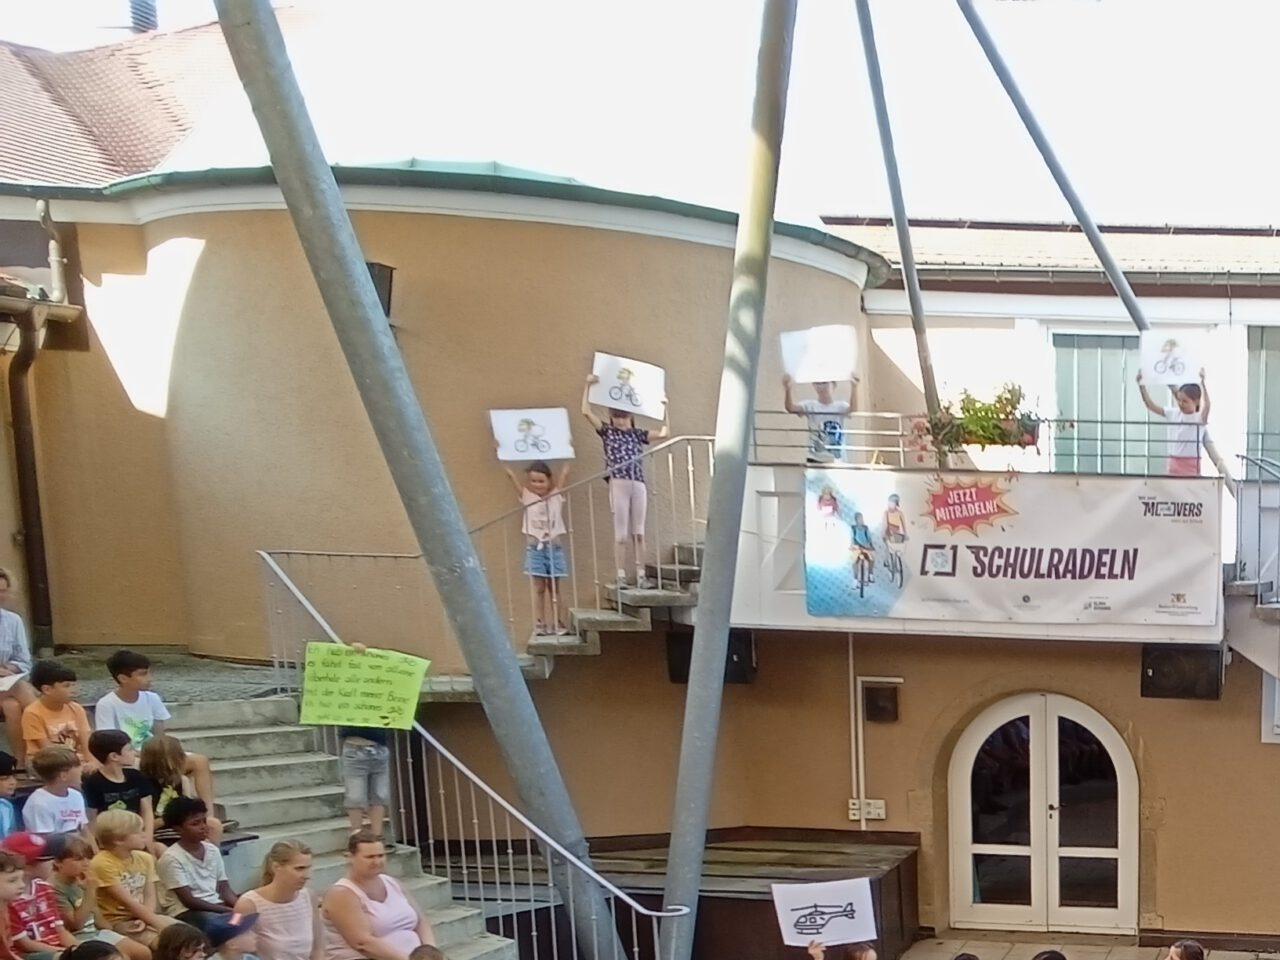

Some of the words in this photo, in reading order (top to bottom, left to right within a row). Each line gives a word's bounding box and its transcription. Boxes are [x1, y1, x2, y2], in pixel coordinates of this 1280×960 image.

[947, 487, 977, 504] JETZT
[935, 499, 998, 521] MITRADELN!
[965, 545, 1139, 581] SCHULRADELN
